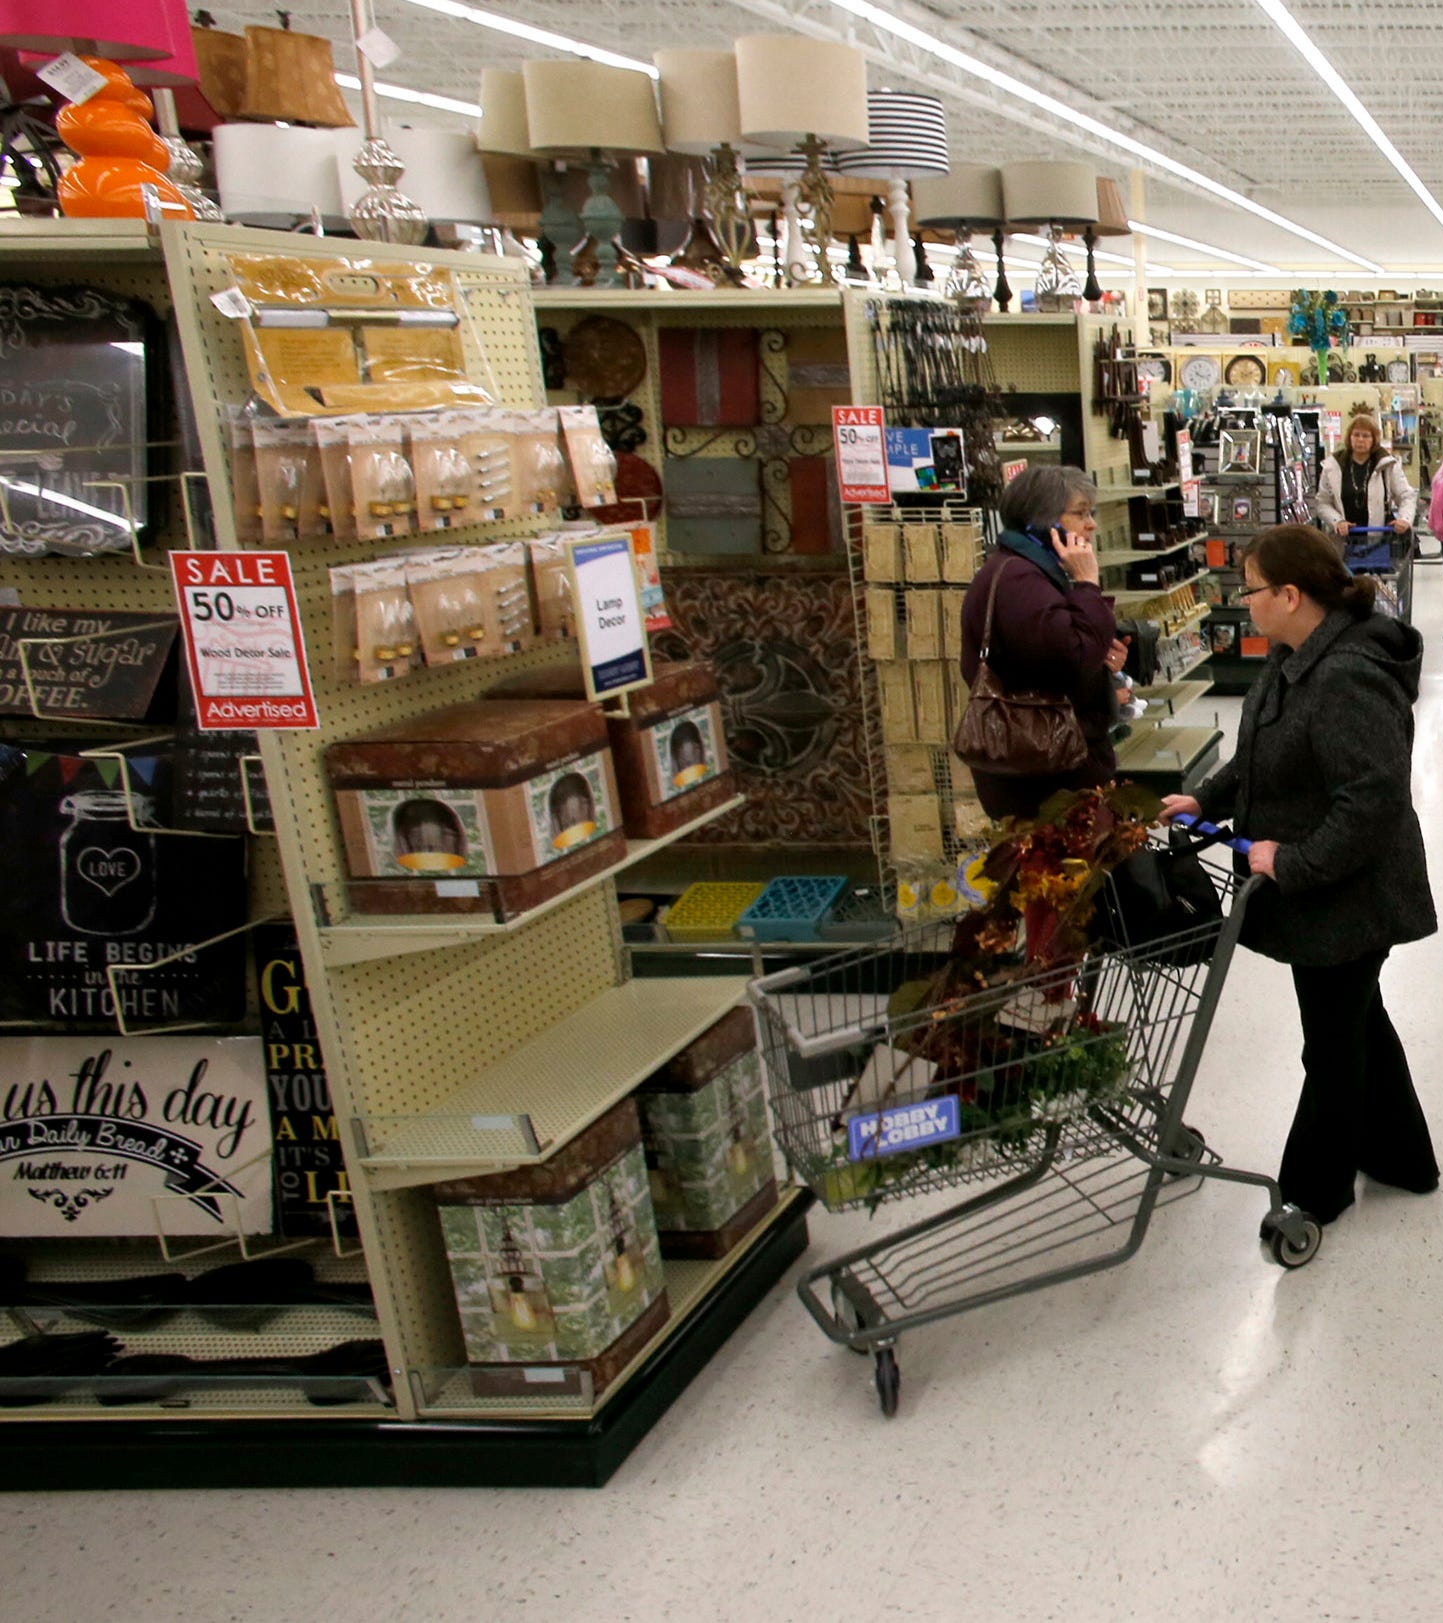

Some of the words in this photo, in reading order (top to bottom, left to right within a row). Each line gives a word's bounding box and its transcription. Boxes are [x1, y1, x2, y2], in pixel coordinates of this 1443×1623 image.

[838, 410, 877, 424] SALE
[186, 558, 276, 583] SALE
[255, 605, 285, 618] OFF
[596, 597, 623, 612] Lamp
[6, 613, 16, 631] I
[22, 612, 67, 632] like
[73, 619, 111, 636] my
[598, 615, 627, 630] Decor
[70, 637, 156, 688] Sugar
[201, 648, 231, 659] Wood
[235, 648, 264, 659] Decor
[268, 648, 291, 659] Sale
[69, 668, 91, 682] of
[207, 702, 308, 719] Advertised
[89, 861, 126, 877] LOVE
[29, 941, 88, 963] LIFE
[106, 942, 198, 964] BEGINS
[50, 988, 179, 1017] KITCHEN
[269, 1044, 325, 1069] PR
[3, 1080, 57, 1121] us
[69, 1049, 148, 1121] this
[163, 1058, 256, 1159] day
[276, 1116, 297, 1141] A
[860, 1103, 940, 1138] HOBBY
[877, 1115, 949, 1148] LOBBY
[27, 1120, 92, 1151] Daily
[96, 1122, 168, 1162] Bread
[280, 1147, 330, 1167] IT'S
[13, 1161, 92, 1180] Matthew
